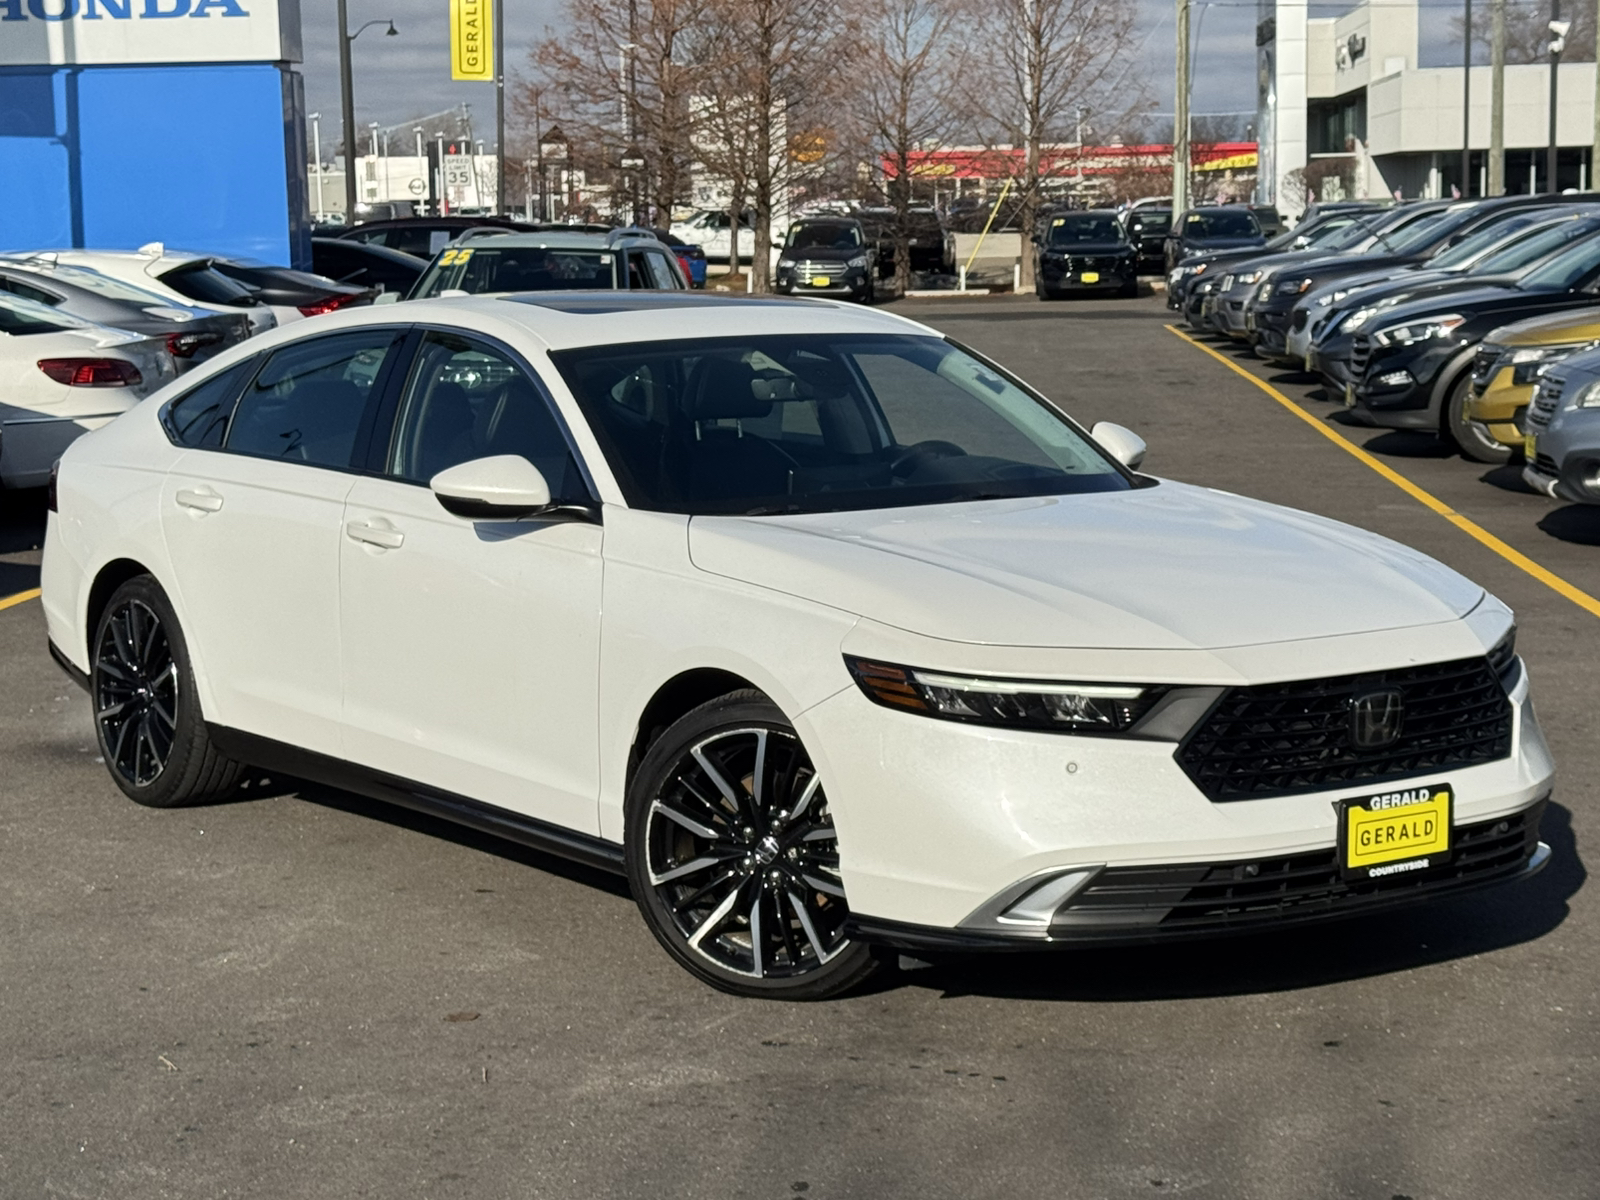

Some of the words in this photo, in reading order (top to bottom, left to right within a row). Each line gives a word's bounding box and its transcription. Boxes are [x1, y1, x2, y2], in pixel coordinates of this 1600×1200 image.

[448, 171, 469, 184] 35
[438, 249, 475, 266] 25
[1370, 788, 1430, 811] GERALD
[1360, 819, 1434, 847] GERALD
